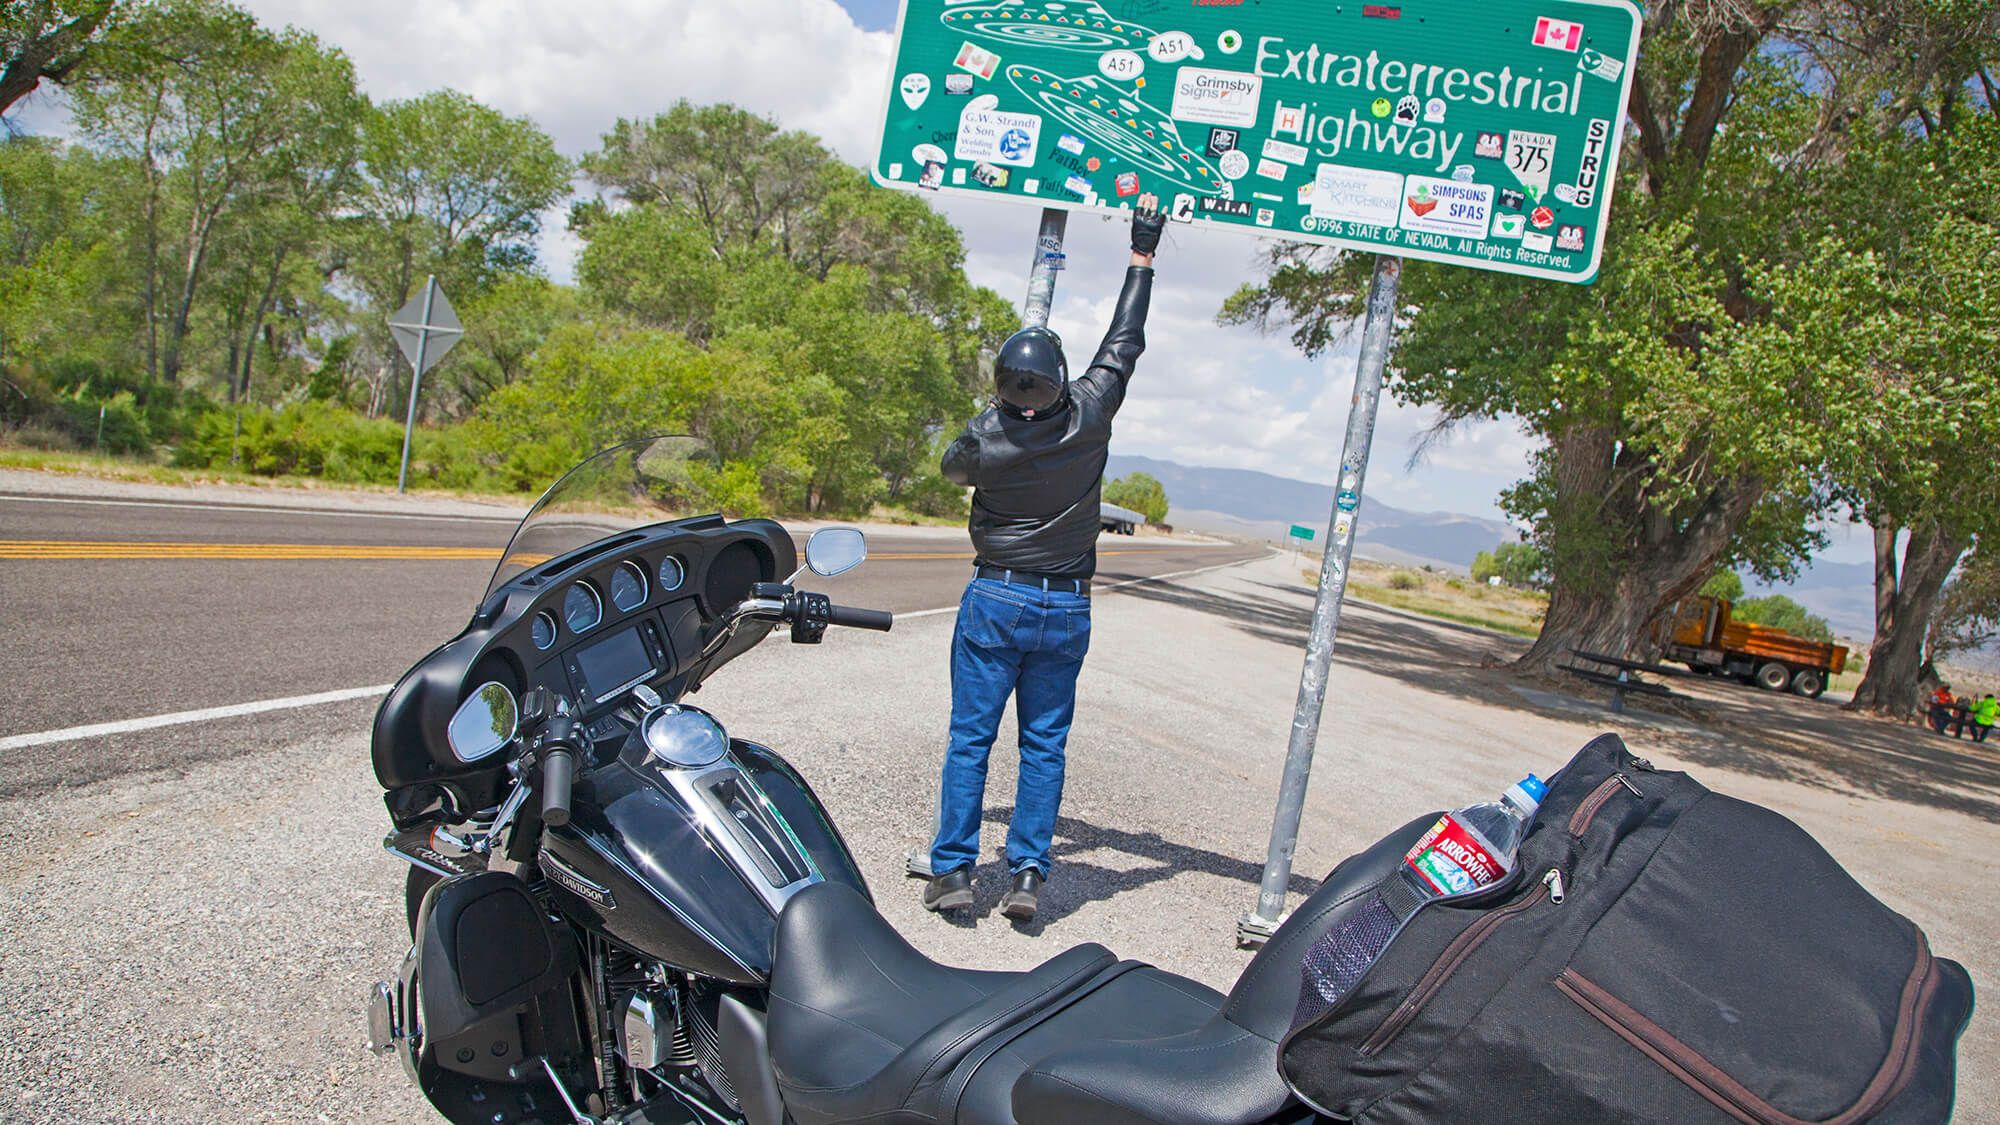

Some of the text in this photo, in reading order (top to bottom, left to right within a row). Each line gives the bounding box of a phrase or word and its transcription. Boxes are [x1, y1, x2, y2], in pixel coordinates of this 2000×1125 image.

[1158, 40, 1184, 55] A51
[1107, 58, 1134, 72] A51
[1196, 74, 1254, 95] Grimsby
[1254, 36, 1583, 116] Extraterrestrial
[1180, 83, 1220, 100] Signs
[1282, 113, 1296, 128] H
[962, 124, 995, 136] & Son
[1271, 100, 1464, 172] Highway
[1512, 132, 1552, 146] NEVADA
[1512, 144, 1548, 173] 375
[1575, 121, 1604, 206] STRUG
[1432, 184, 1487, 202] SIMPSONS
[1449, 202, 1484, 220] SPAS
[1040, 237, 1060, 252] MSC
[1348, 223, 1381, 240] STATE
[1386, 228, 1401, 242] OF
[1404, 231, 1452, 251] NEVADA.
[1457, 238, 1472, 253] All
[1476, 241, 1512, 261] Rights
[1516, 247, 1572, 269] Reserved.
[1436, 837, 1494, 887] ARROWHE
